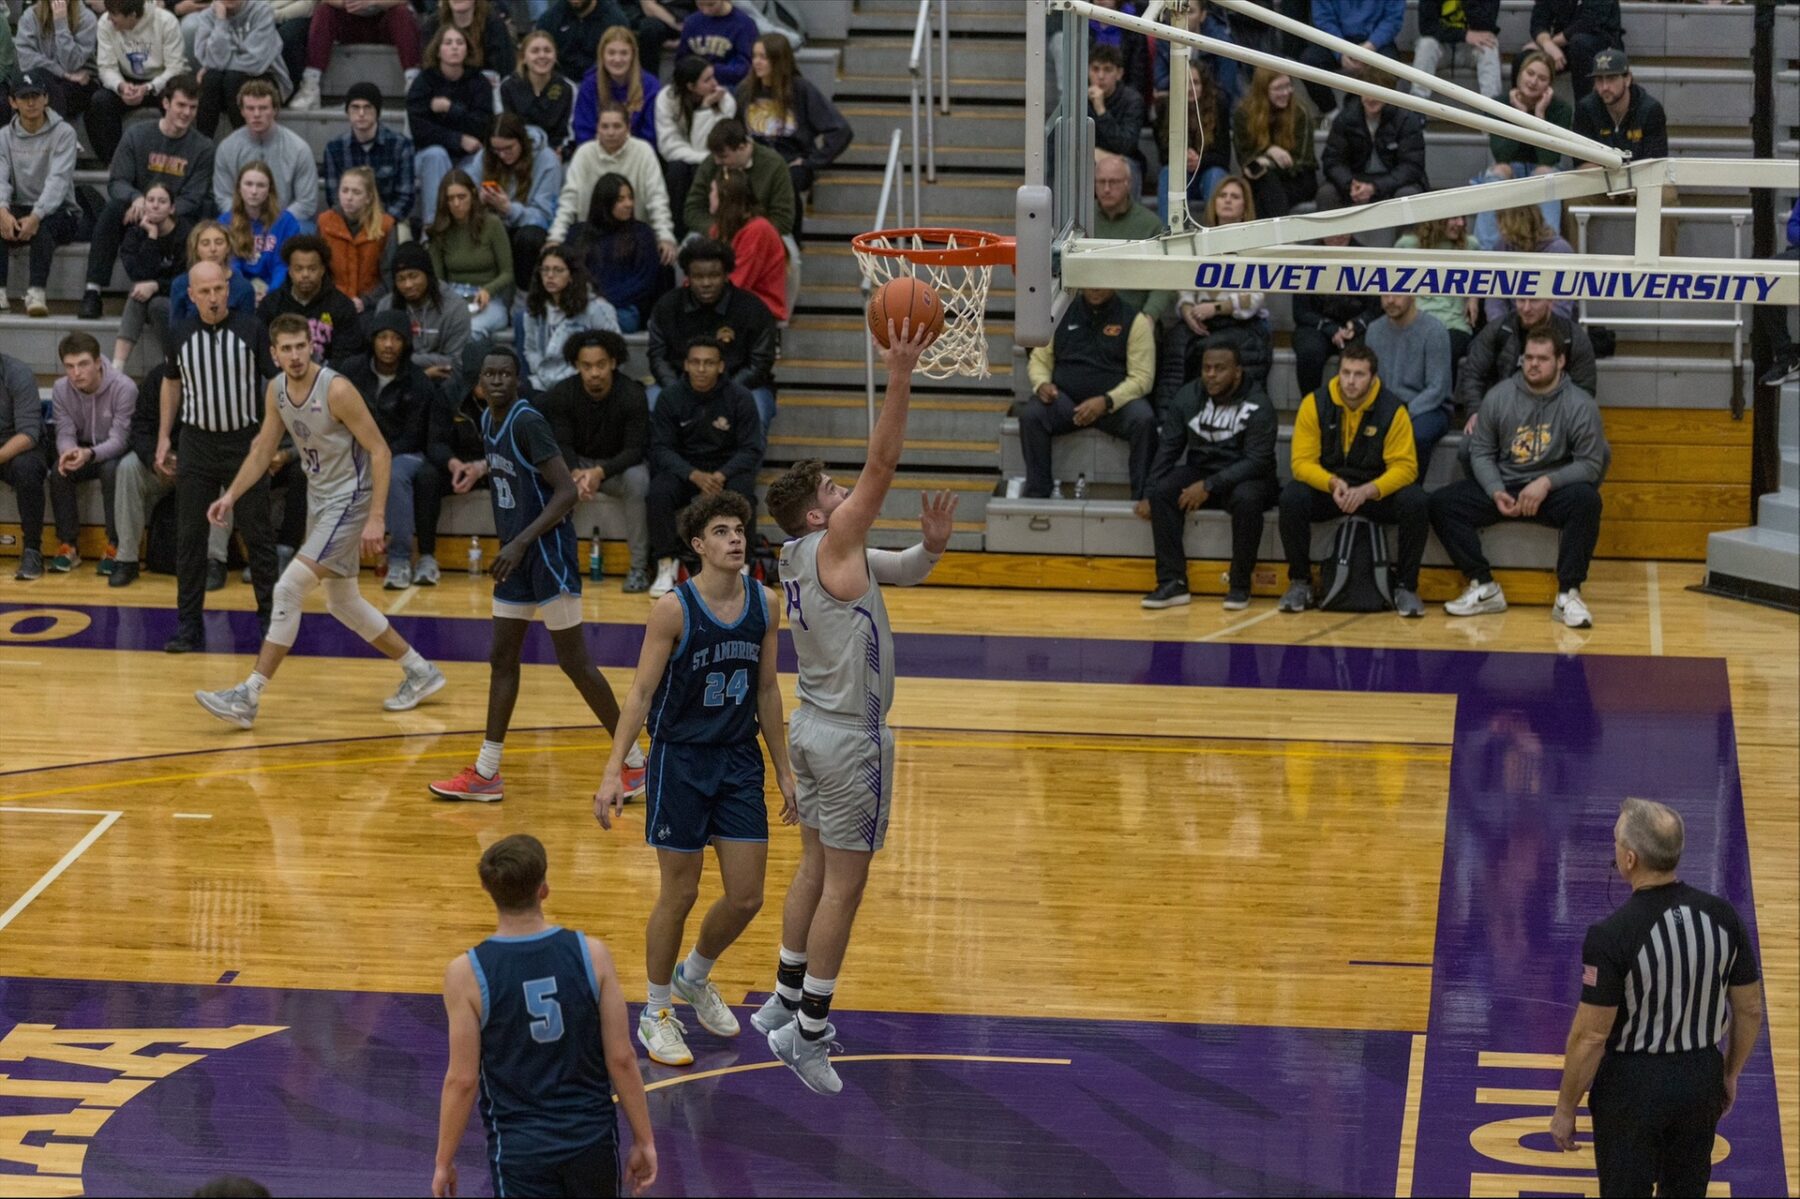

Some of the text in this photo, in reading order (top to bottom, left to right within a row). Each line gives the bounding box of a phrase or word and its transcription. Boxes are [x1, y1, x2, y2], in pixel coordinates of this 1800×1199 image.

[1194, 262, 1781, 302] OLIVET NAZARENE UNIVERSITY
[703, 668, 750, 707] 24
[522, 976, 565, 1044] 5
